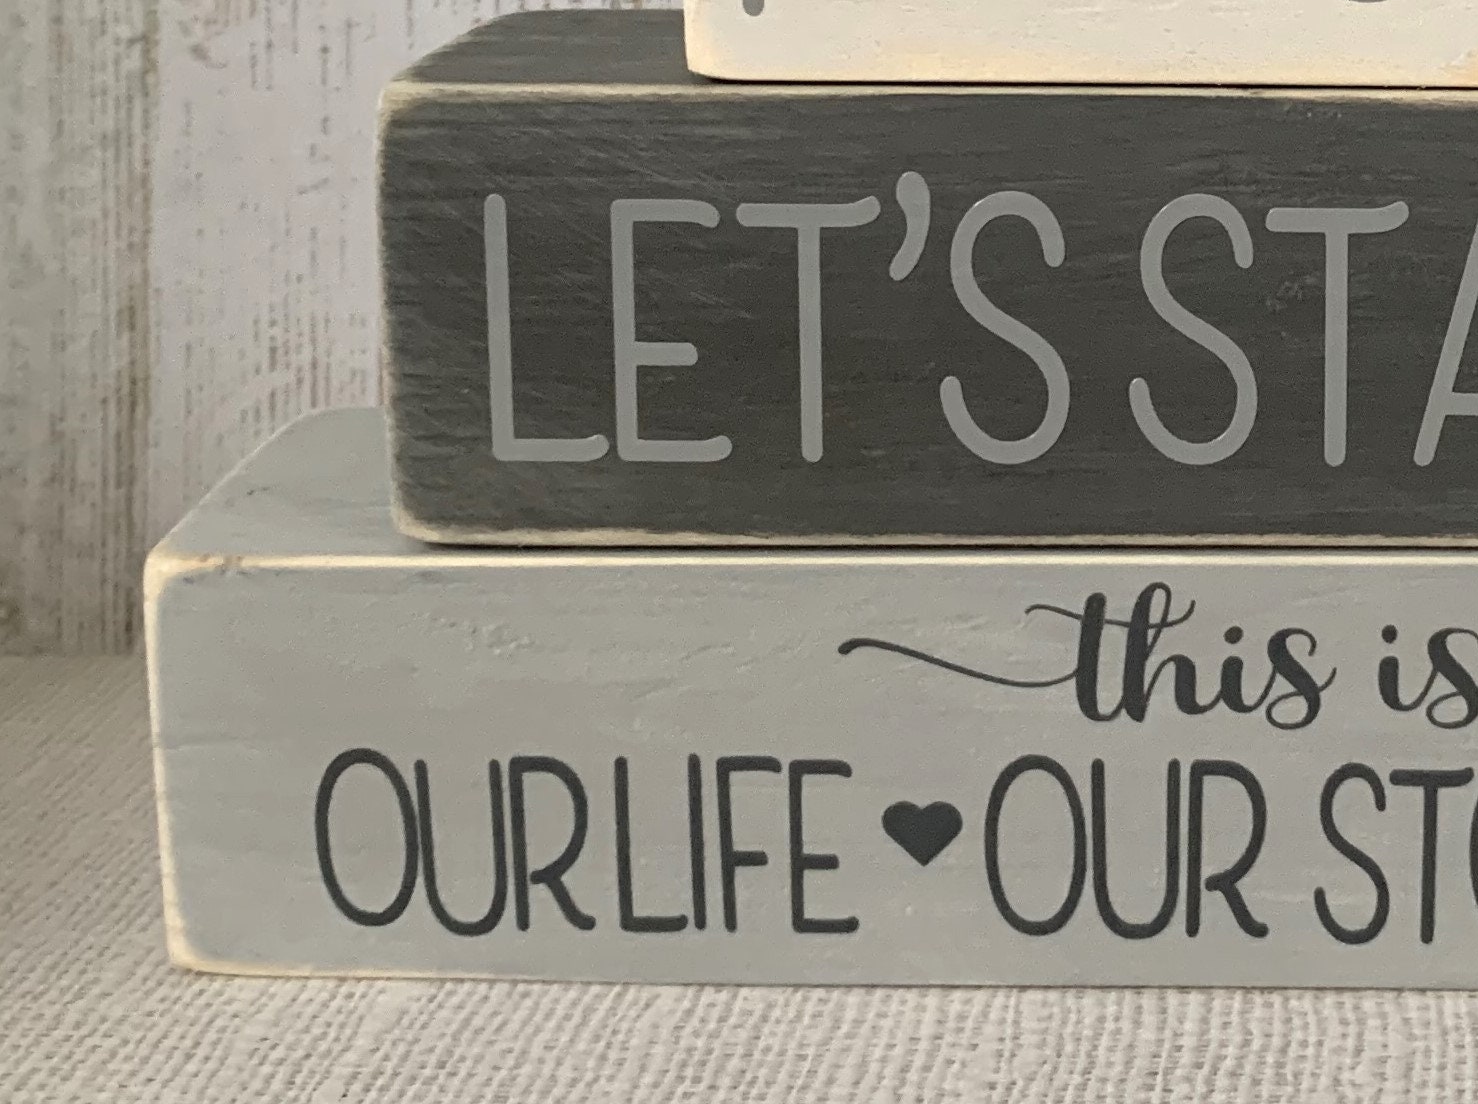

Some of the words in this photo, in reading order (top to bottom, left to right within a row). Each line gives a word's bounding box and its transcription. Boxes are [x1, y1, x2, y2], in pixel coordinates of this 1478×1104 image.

[483, 170, 1070, 465] LET'S
[837, 582, 1337, 731] this
[314, 748, 596, 937] OUR
[614, 753, 860, 934] LIFE
[984, 754, 1269, 940] OUR
